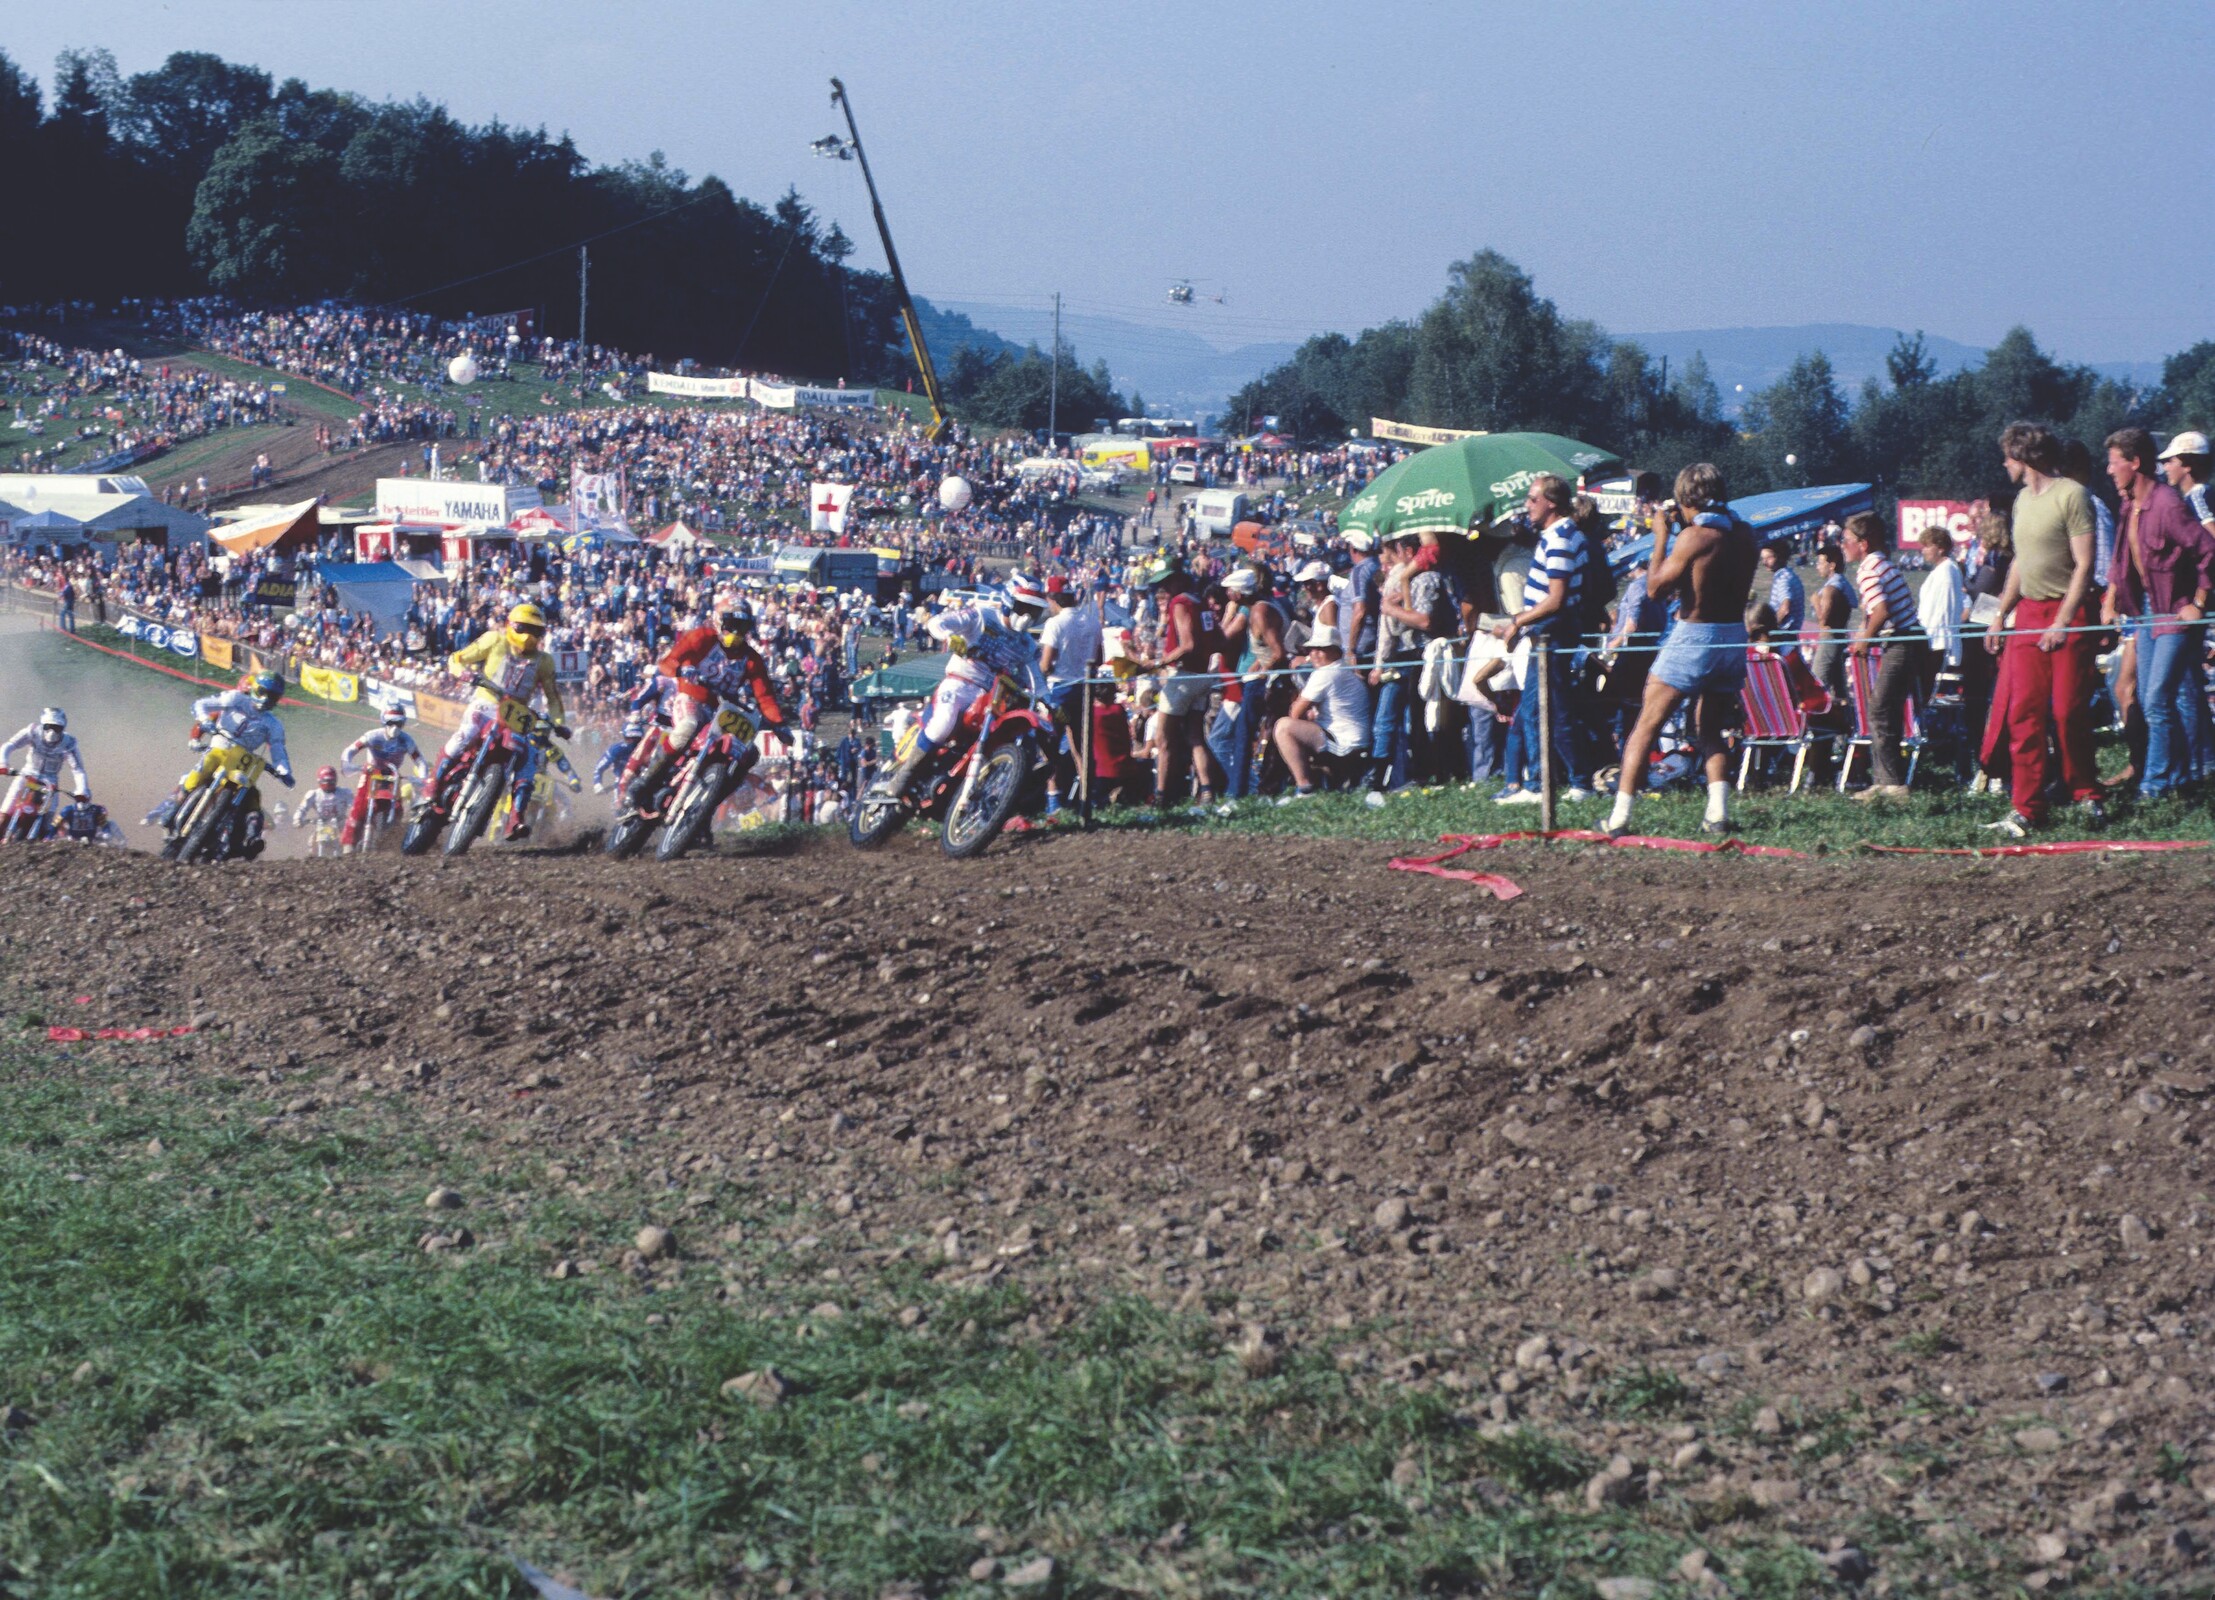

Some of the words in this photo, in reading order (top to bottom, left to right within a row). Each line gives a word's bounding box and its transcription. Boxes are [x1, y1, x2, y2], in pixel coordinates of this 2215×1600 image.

[444, 501, 500, 521] YAMAHA
[1395, 488, 1456, 516] Sprite
[1902, 505, 1972, 542] Blic
[257, 582, 294, 597] ADIA
[504, 703, 530, 735] 14
[720, 712, 752, 742] 28
